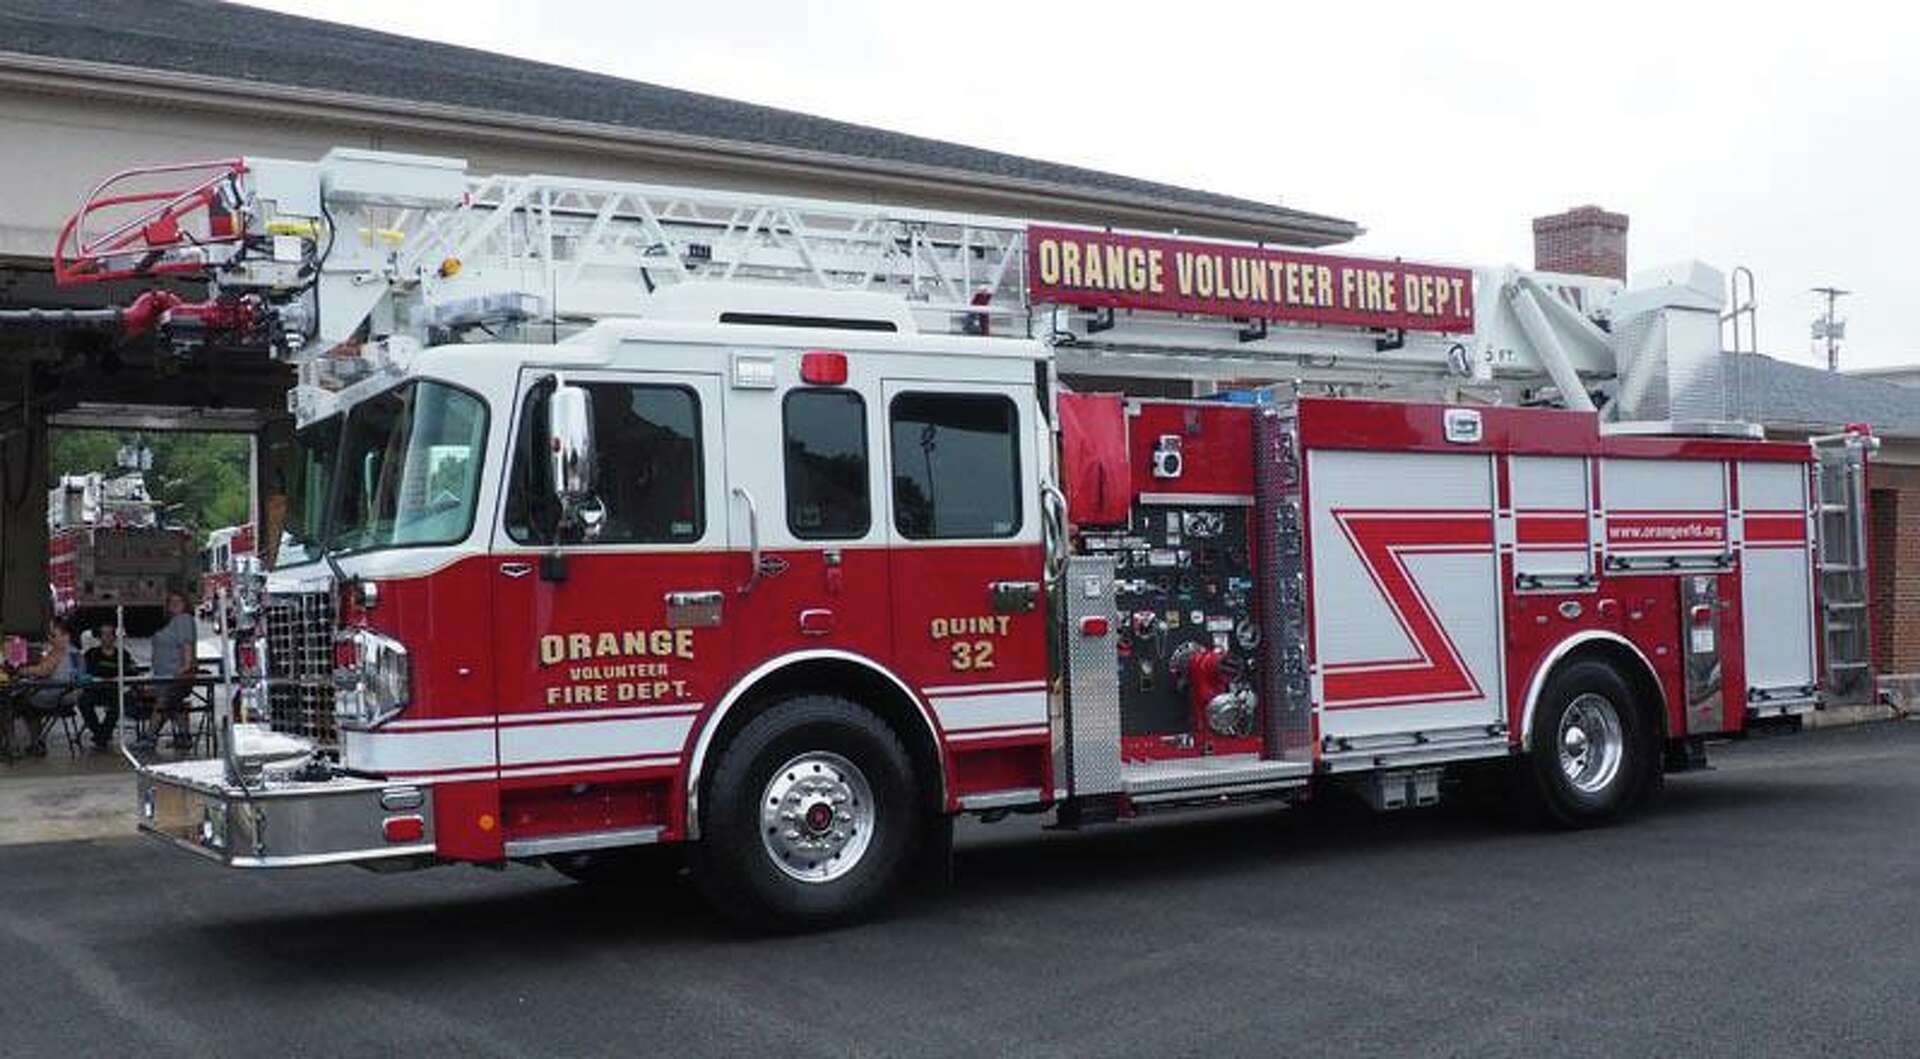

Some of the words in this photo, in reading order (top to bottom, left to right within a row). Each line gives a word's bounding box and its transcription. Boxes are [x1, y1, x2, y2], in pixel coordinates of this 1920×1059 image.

[1039, 239, 1164, 293] ORANGE
[1176, 252, 1334, 309] VOLUNTEER
[1342, 268, 1398, 311] FIRE
[1404, 273, 1471, 318] DEPT.
[1609, 524, 1722, 539] www.orangevfd.org
[930, 614, 1012, 639] QUINT
[539, 629, 695, 666] ORANGE
[951, 640, 996, 670] 32
[569, 663, 669, 682] VOLUNTEER
[546, 684, 609, 705] FIRE
[616, 680, 693, 702] DEPT.
